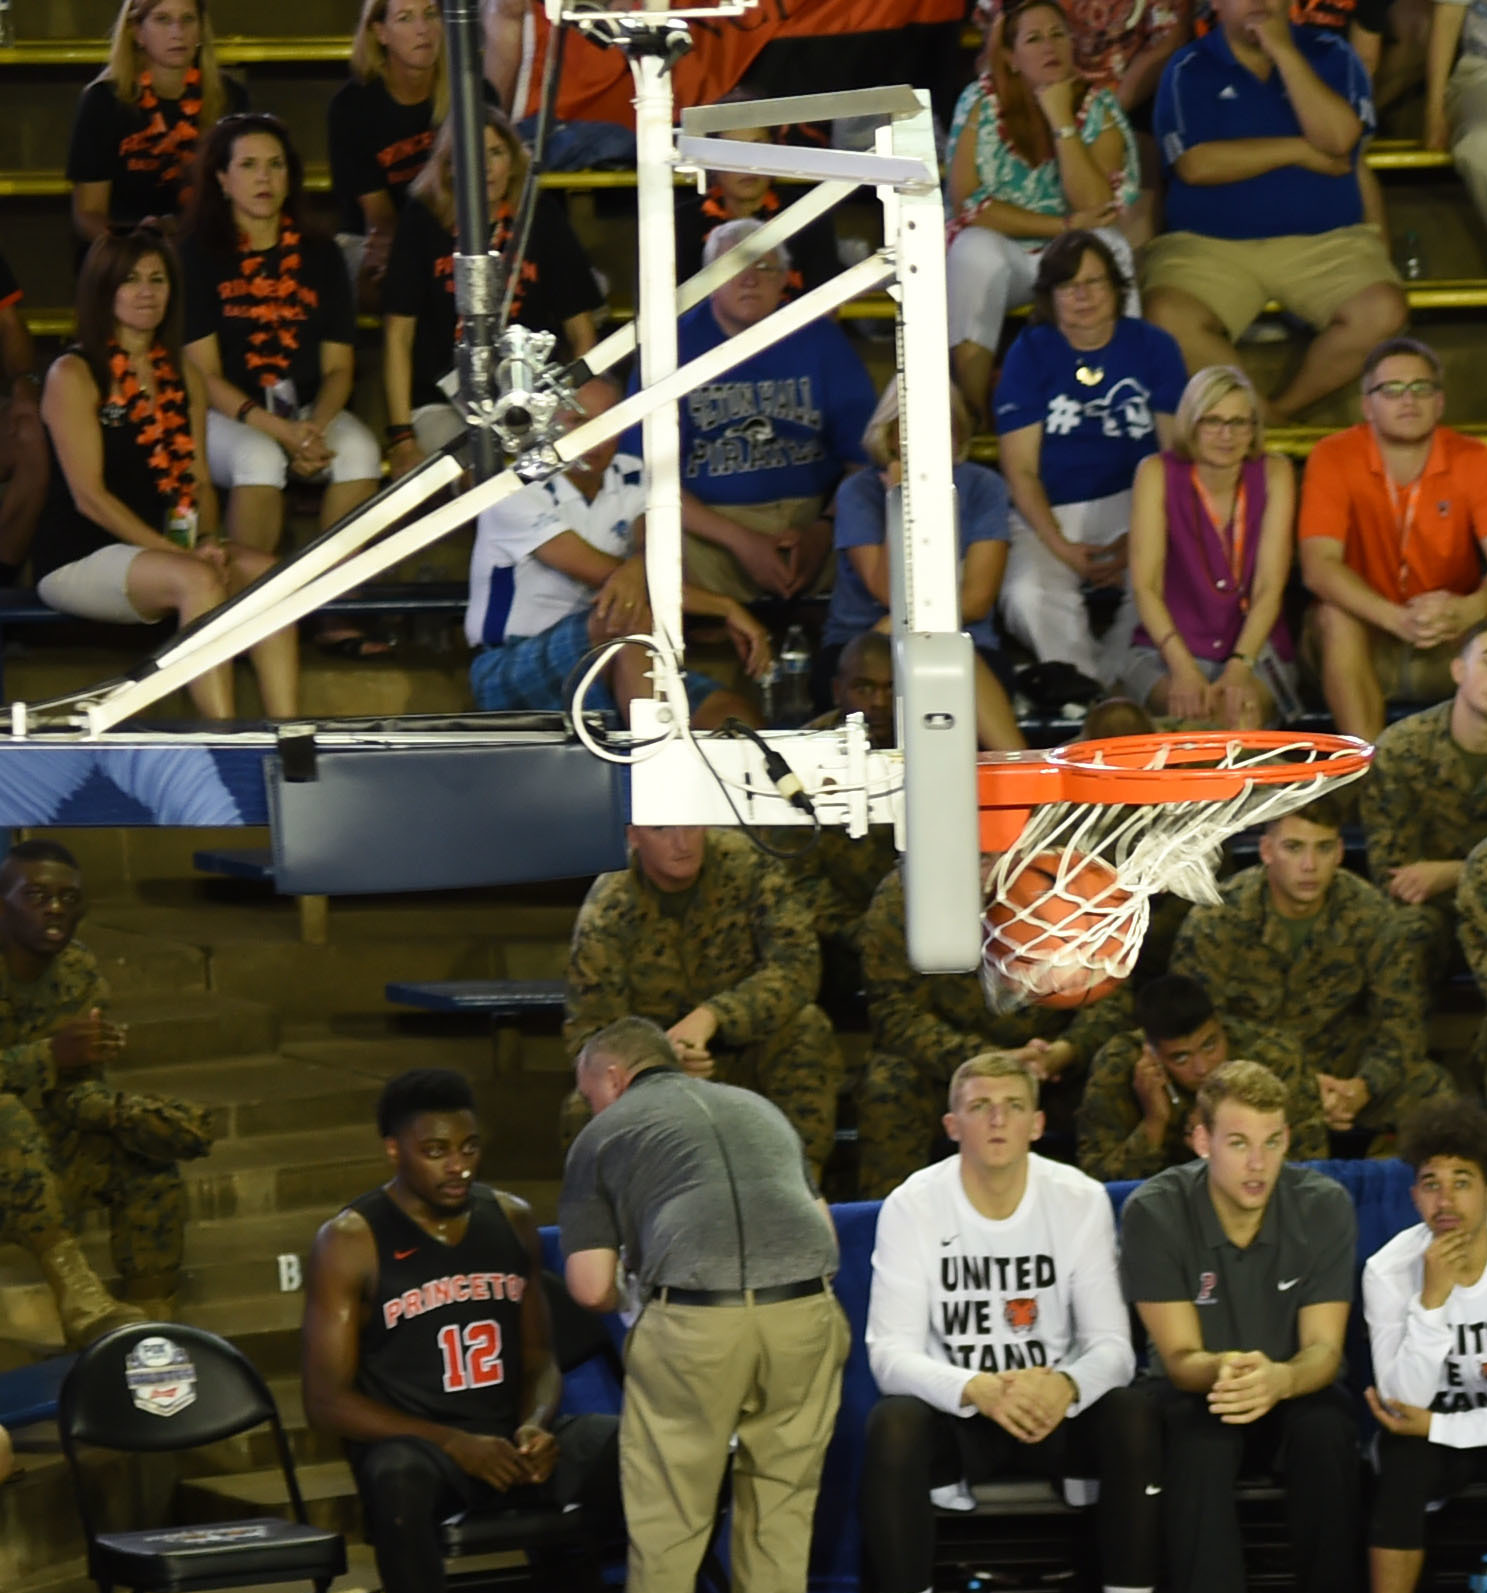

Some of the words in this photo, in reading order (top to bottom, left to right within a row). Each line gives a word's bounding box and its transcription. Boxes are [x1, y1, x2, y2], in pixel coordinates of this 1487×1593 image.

[278, 1254, 301, 1292] B
[941, 1254, 1056, 1292] UNITED
[383, 1273, 528, 1330] PRINCETO
[942, 1299, 992, 1336] WE
[438, 1319, 504, 1393] 12
[1443, 1359, 1464, 1388] E
